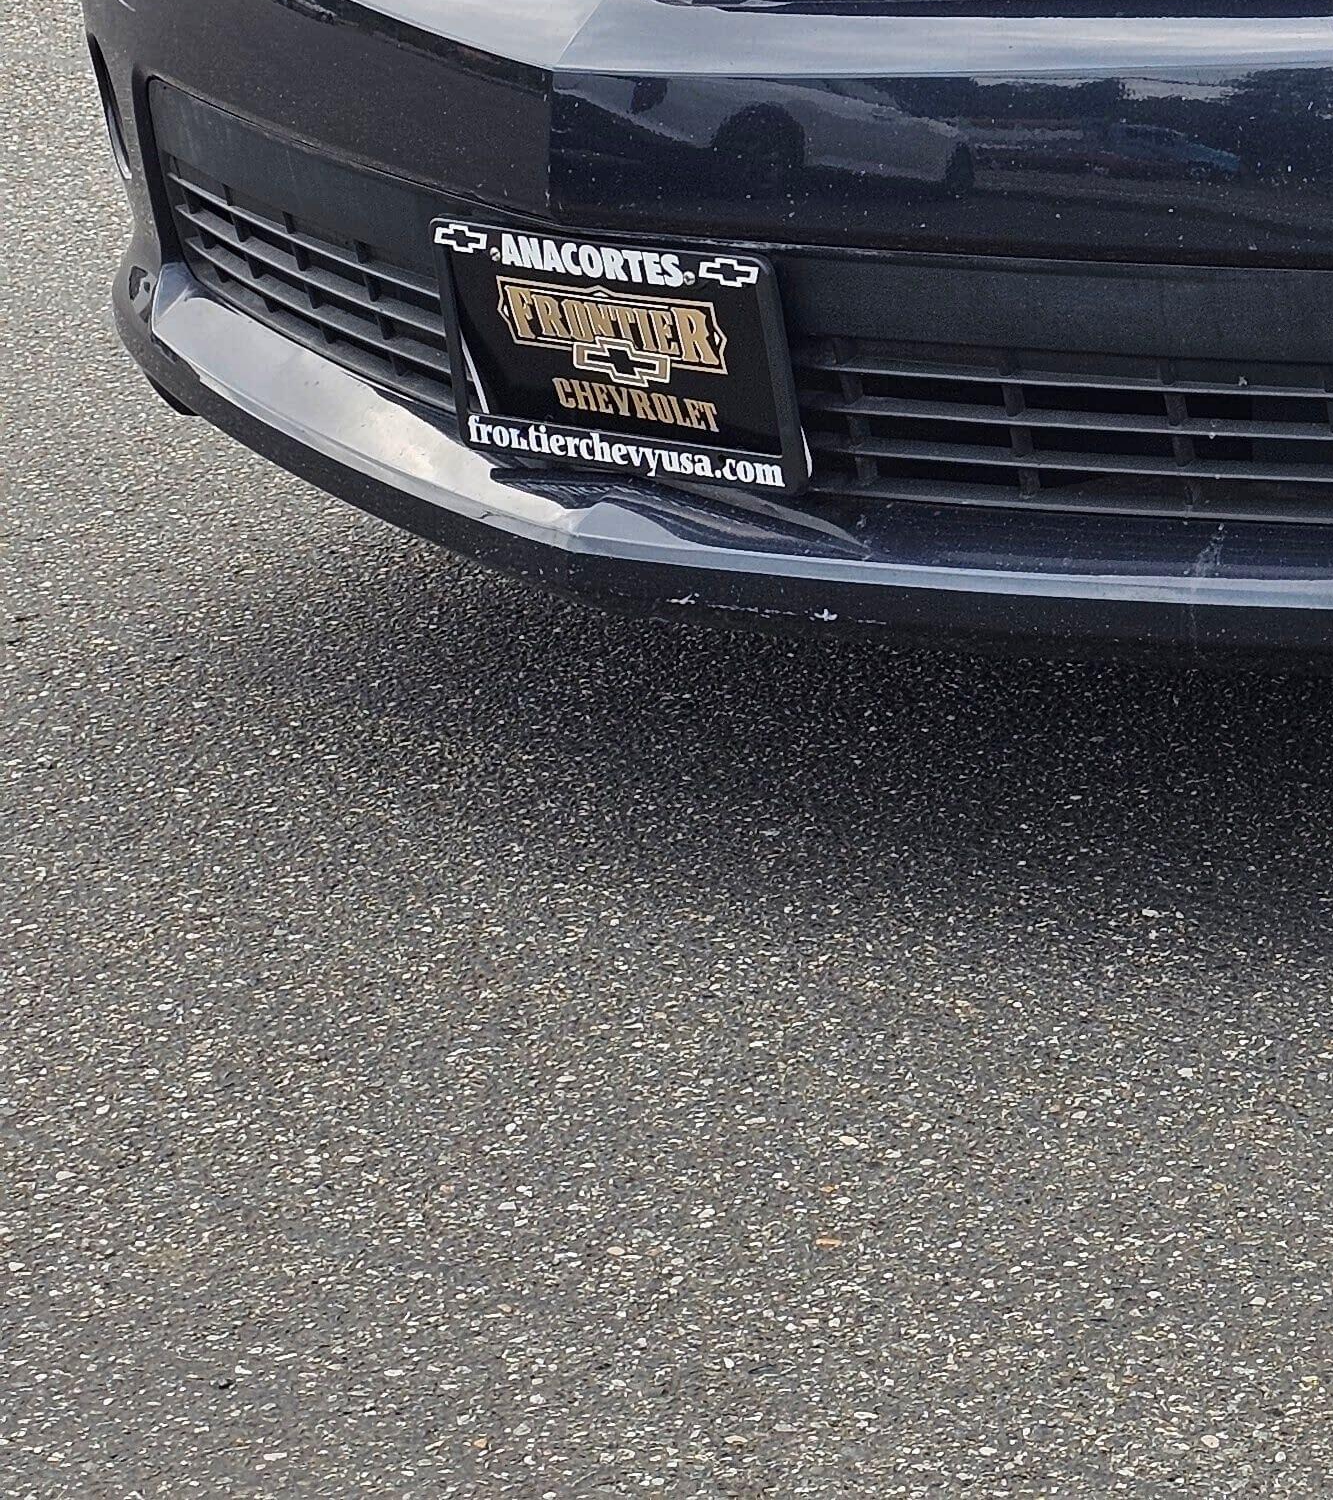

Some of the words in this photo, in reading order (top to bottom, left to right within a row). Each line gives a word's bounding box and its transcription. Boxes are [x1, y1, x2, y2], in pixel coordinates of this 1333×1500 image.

[500, 233, 683, 287] ANACORTES
[504, 285, 716, 365] FRONTIER
[552, 377, 720, 433] CHEVROLET
